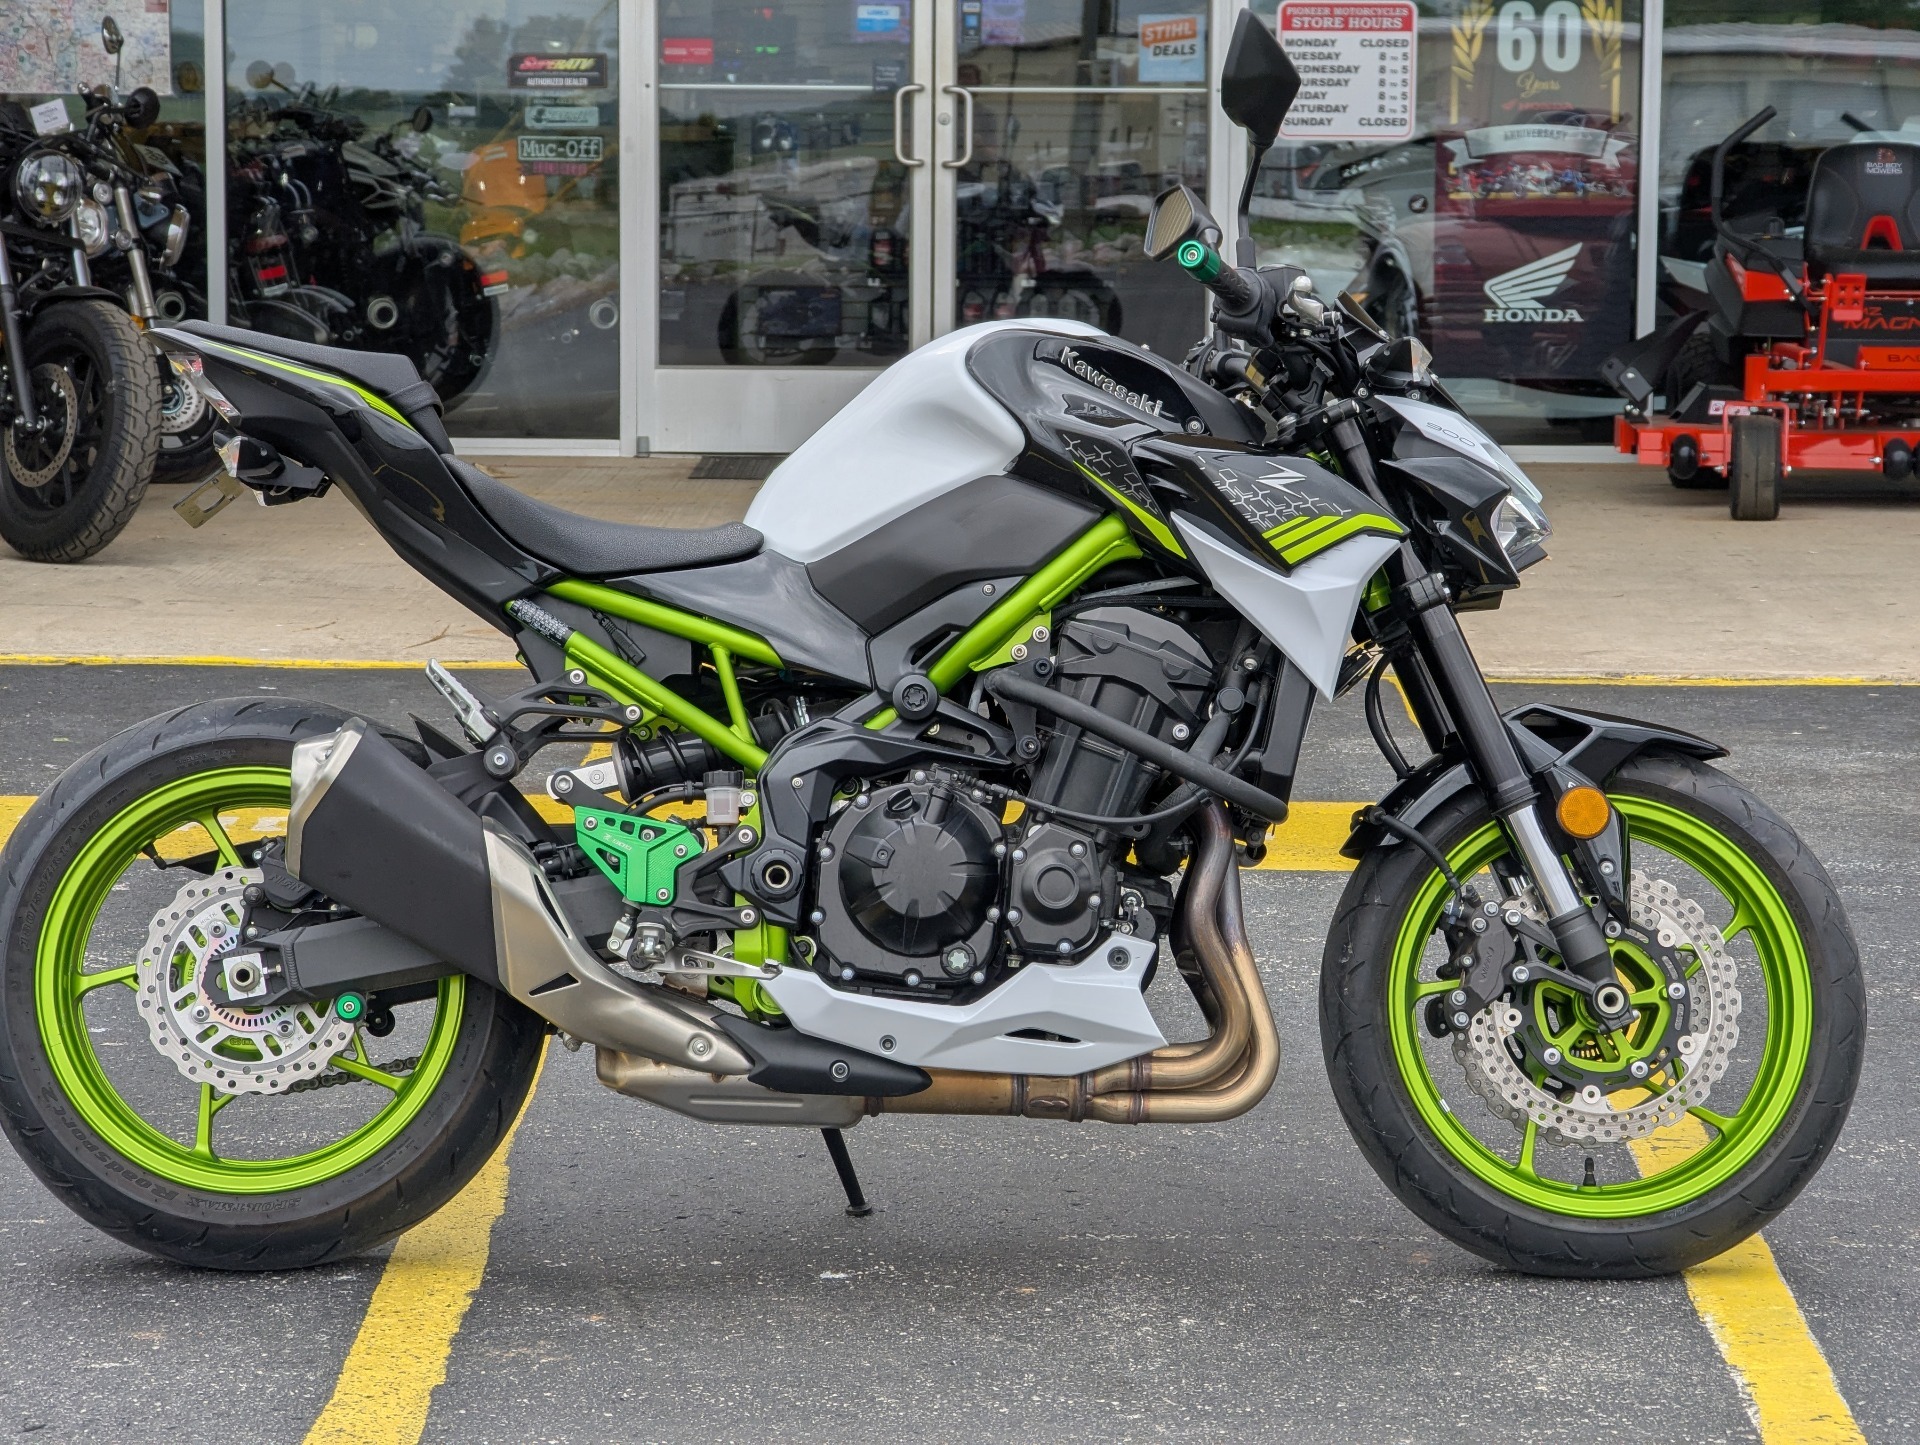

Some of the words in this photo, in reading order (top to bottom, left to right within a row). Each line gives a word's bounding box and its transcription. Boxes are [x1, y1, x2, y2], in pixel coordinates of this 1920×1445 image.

[1286, 7, 1331, 15] PIONEER
[1334, 7, 1409, 16] MOTORCYCLES
[1292, 17, 1344, 28] STORE
[1348, 17, 1403, 29] HOURS
[1145, 22, 1192, 41] STIHL
[1497, 0, 1582, 72] 60
[1284, 39, 1337, 47] MONDAY
[1360, 39, 1409, 48] CLOSED
[1153, 43, 1197, 57] DEALS
[1379, 52, 1386, 60] 8
[1401, 52, 1409, 60] 5
[1296, 65, 1361, 74] EDNESDAY
[1379, 65, 1386, 74] 8
[1401, 65, 1409, 74] 5
[527, 77, 563, 86] AUTHORIZED
[564, 78, 589, 86] DEALER
[1302, 78, 1350, 87] URSDAY
[1379, 78, 1386, 87] 8
[1401, 78, 1408, 87] 5
[1378, 92, 1386, 100] 8
[1401, 92, 1408, 100] 5
[1288, 104, 1349, 113] ATURDAY
[1378, 105, 1385, 113] 8
[1401, 105, 1408, 113] 3
[1284, 117, 1333, 126] SUNDAY
[1358, 118, 1408, 127] CLOSED
[522, 140, 598, 157] Muc-Off
[1483, 309, 1584, 322] HONDA
[1888, 354, 1920, 362] BA
[1060, 346, 1163, 417] Kawasaki
[1426, 421, 1476, 447] 900
